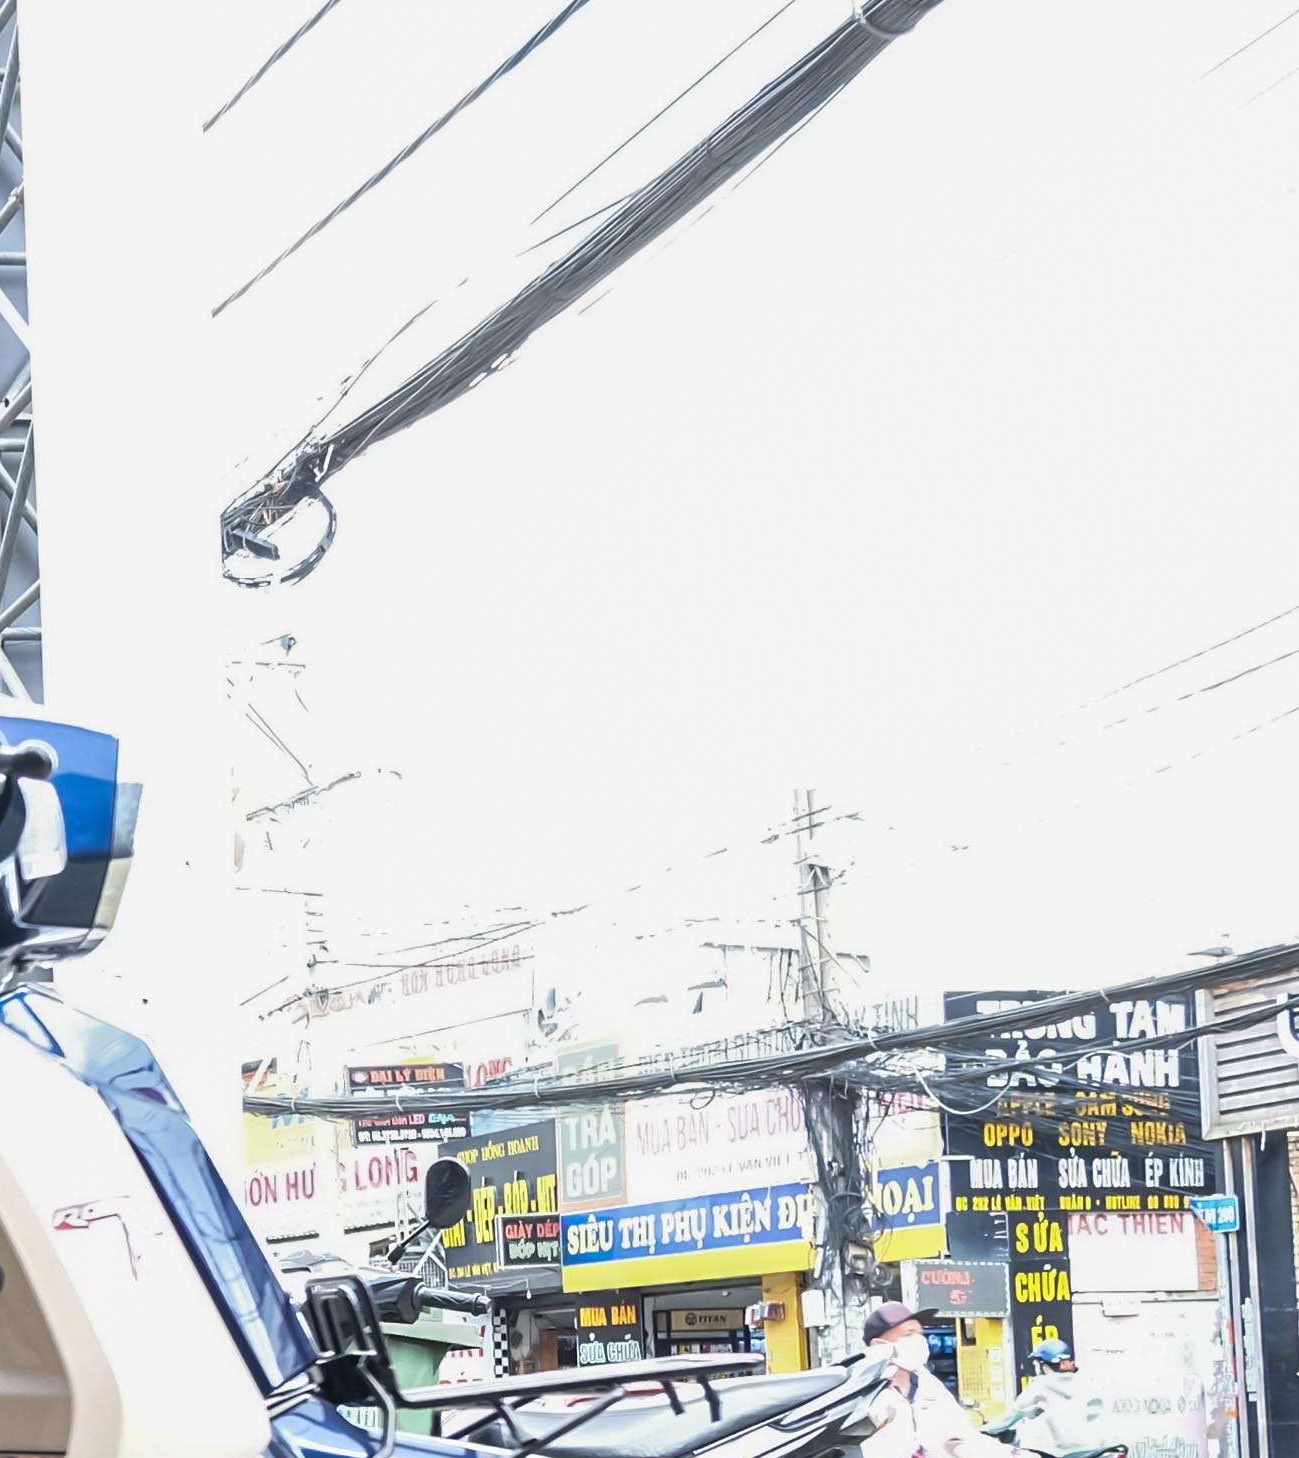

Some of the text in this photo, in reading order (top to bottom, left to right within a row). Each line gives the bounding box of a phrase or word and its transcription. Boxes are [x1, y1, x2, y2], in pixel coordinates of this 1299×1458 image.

[983, 1120, 1187, 1147] OPPO SONY NOKIA
[566, 1152, 617, 1198] GÓP
[970, 1158, 1003, 1189] MUA
[567, 1214, 614, 1255] SIÊU
[618, 1214, 655, 1253] THỊ
[661, 1206, 707, 1249] PHỤ
[1016, 1211, 1063, 1253] SỬA
[1015, 1264, 1070, 1303] CHỮA
[580, 1300, 636, 1328] MUA BÁN
